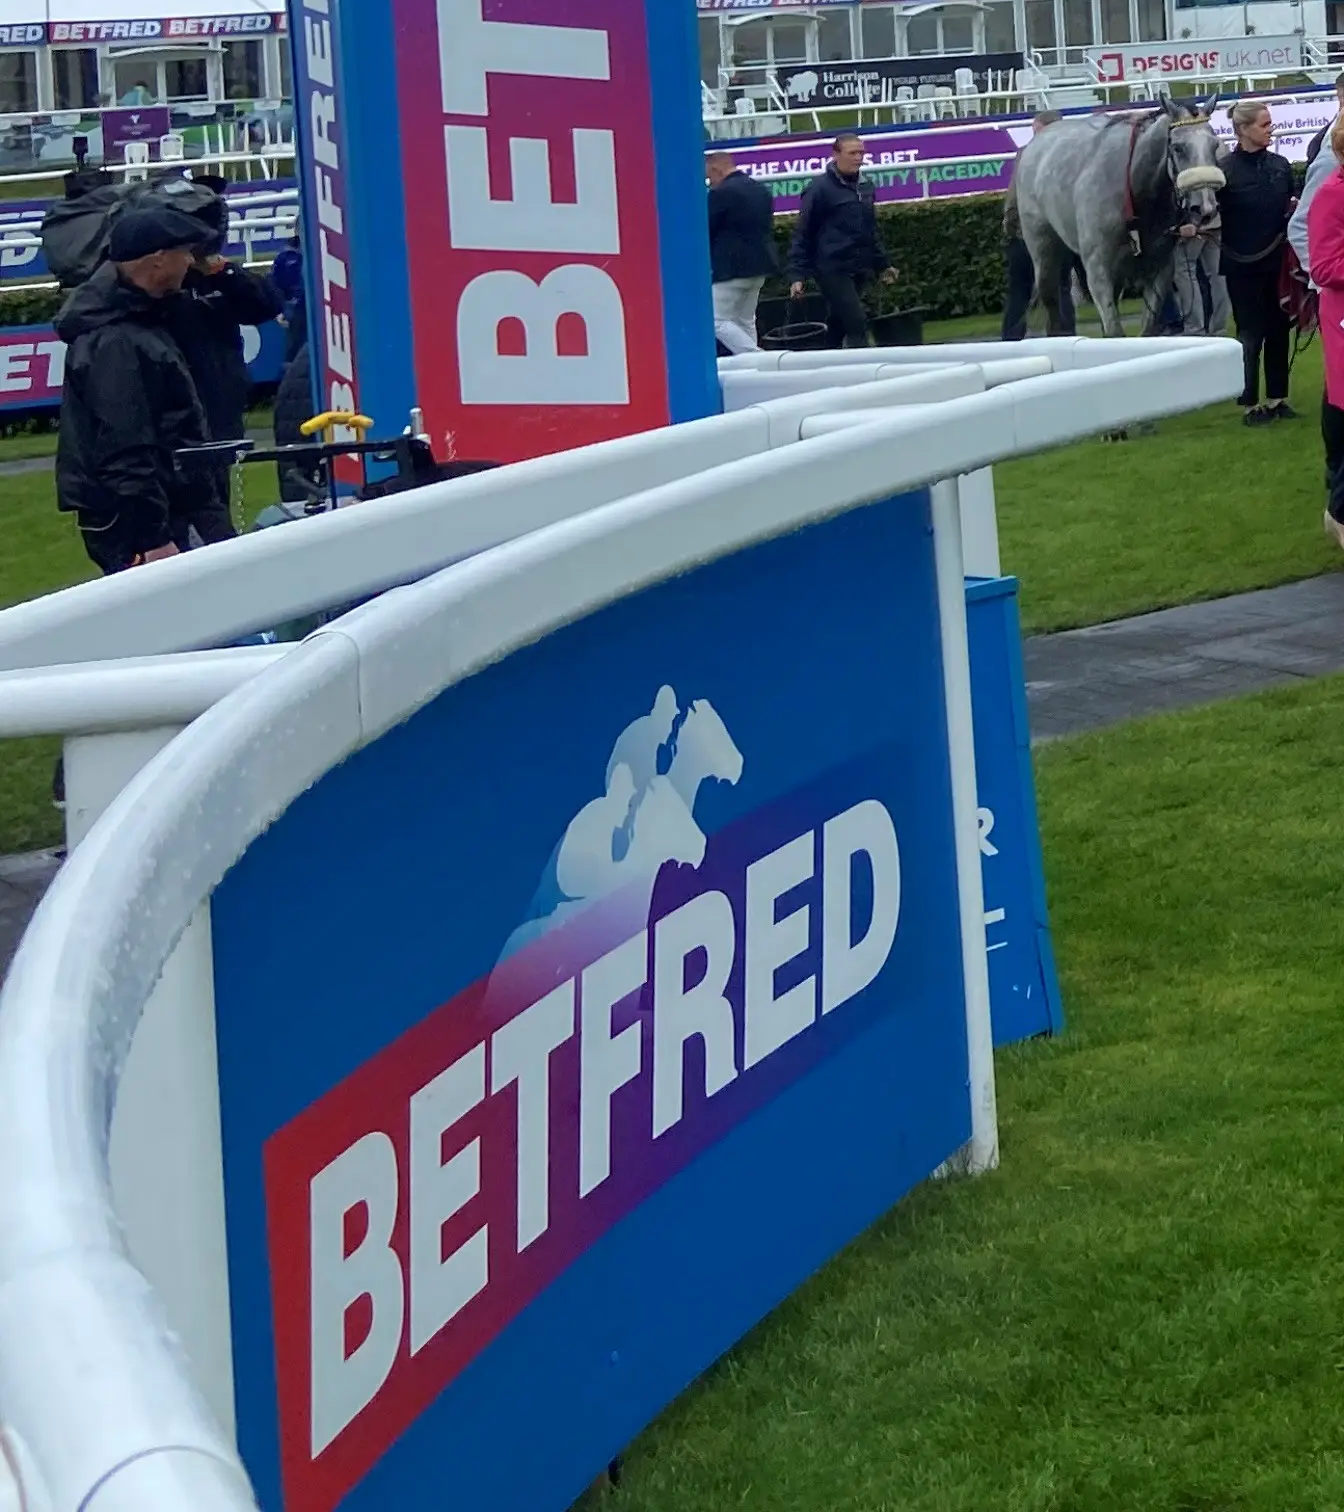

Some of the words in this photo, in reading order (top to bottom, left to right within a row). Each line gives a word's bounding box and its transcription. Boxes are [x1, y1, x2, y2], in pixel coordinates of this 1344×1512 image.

[53, 21, 161, 41] BETFRED
[168, 15, 271, 35] BETFRED
[823, 70, 879, 84] Harrison
[1214, 126, 1233, 136] ake
[1296, 118, 1329, 129] British
[916, 161, 1004, 185] RACEDAY
[309, 799, 902, 1460] BETFRED
